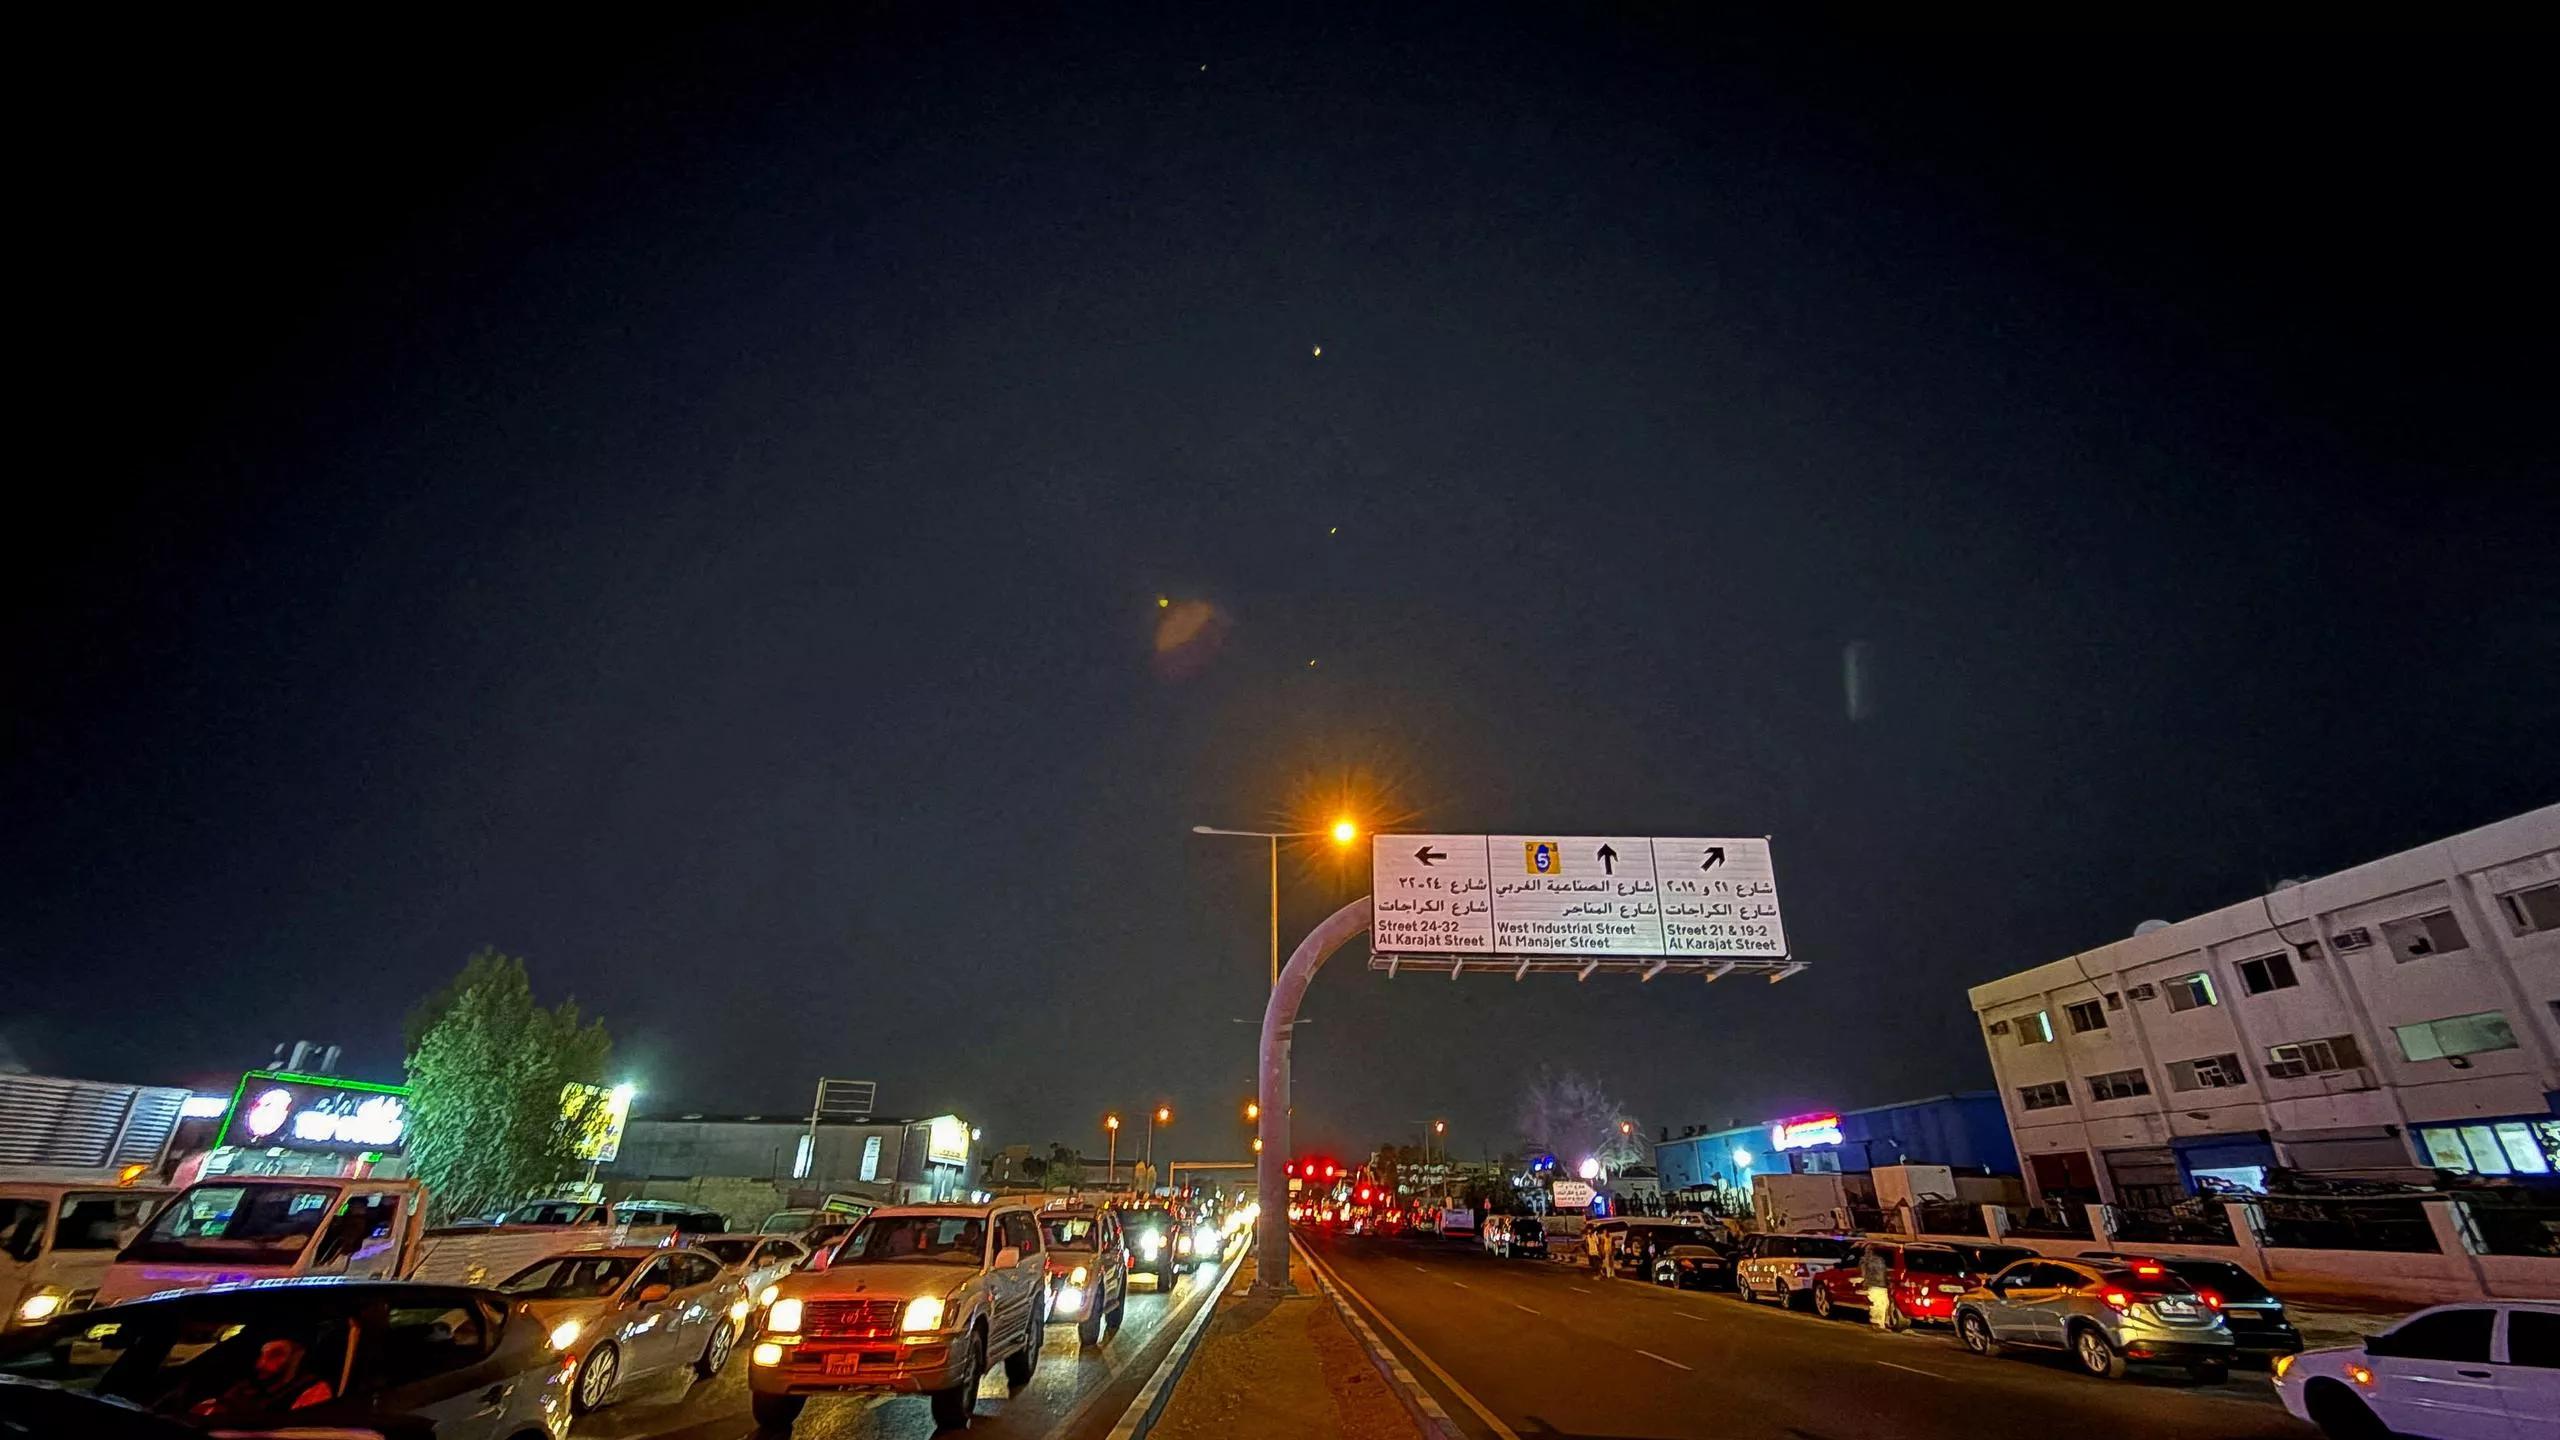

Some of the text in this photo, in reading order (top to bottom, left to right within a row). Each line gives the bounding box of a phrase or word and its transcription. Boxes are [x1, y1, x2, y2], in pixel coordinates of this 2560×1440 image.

[1538, 853, 1548, 868] 5
[1451, 879, 1487, 894] شارع
[1496, 880, 1653, 896] شارع الصناعية الغربي
[1703, 886, 1709, 895] و
[1736, 882, 1772, 897] شارع
[1379, 899, 1488, 916] شارع الكراجات
[1620, 903, 1656, 917] شارع
[1666, 904, 1776, 920] شارع الكراجات
[1379, 921, 1459, 931] Street 24-32
[1498, 923, 1635, 934] West Industrial Street
[1667, 925, 1767, 936] Street 21 & 19-2
[1379, 934, 1484, 947] Al Karajat Street
[1499, 936, 1610, 948] Al Manajer Street
[1670, 938, 1776, 951] Al Karajat Street
